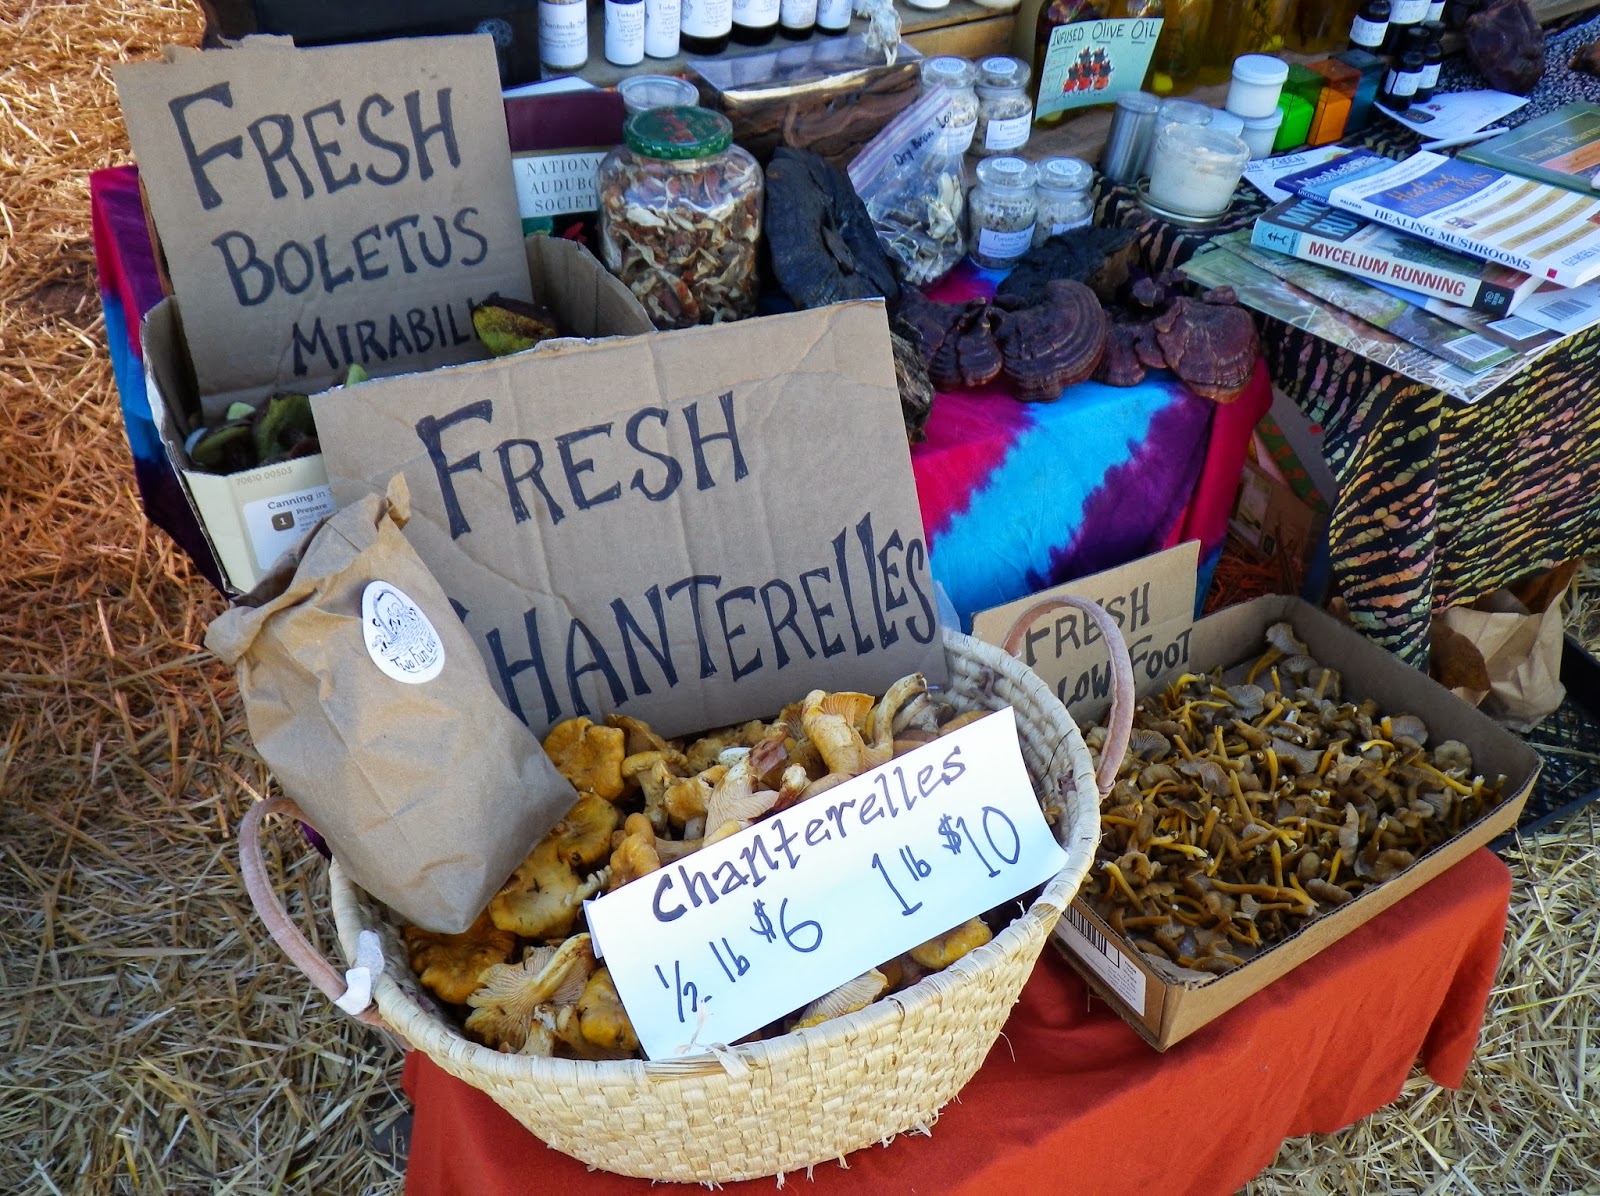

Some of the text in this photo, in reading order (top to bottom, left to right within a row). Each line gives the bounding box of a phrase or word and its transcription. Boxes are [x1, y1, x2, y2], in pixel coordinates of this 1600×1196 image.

[168, 80, 461, 210] FRESH
[527, 157, 600, 176] NATIONA
[530, 177, 597, 195] AUDUBO
[534, 194, 595, 213] SOCIET
[211, 206, 489, 307] BOLETUS
[1308, 241, 1467, 297] MYCELIUM RUNNING
[1374, 209, 1435, 238] HEALING
[1438, 231, 1532, 271] MUSHROOMS
[415, 390, 749, 540] FRESH
[267, 493, 314, 510] Canning
[316, 490, 326, 499] in
[279, 503, 328, 525] 1 Prepare
[447, 511, 937, 728] HANTERELLES
[1025, 581, 1151, 667] FRESH
[709, 935, 750, 982] lb
[898, 844, 932, 881] lb
[938, 806, 1021, 878] $10
